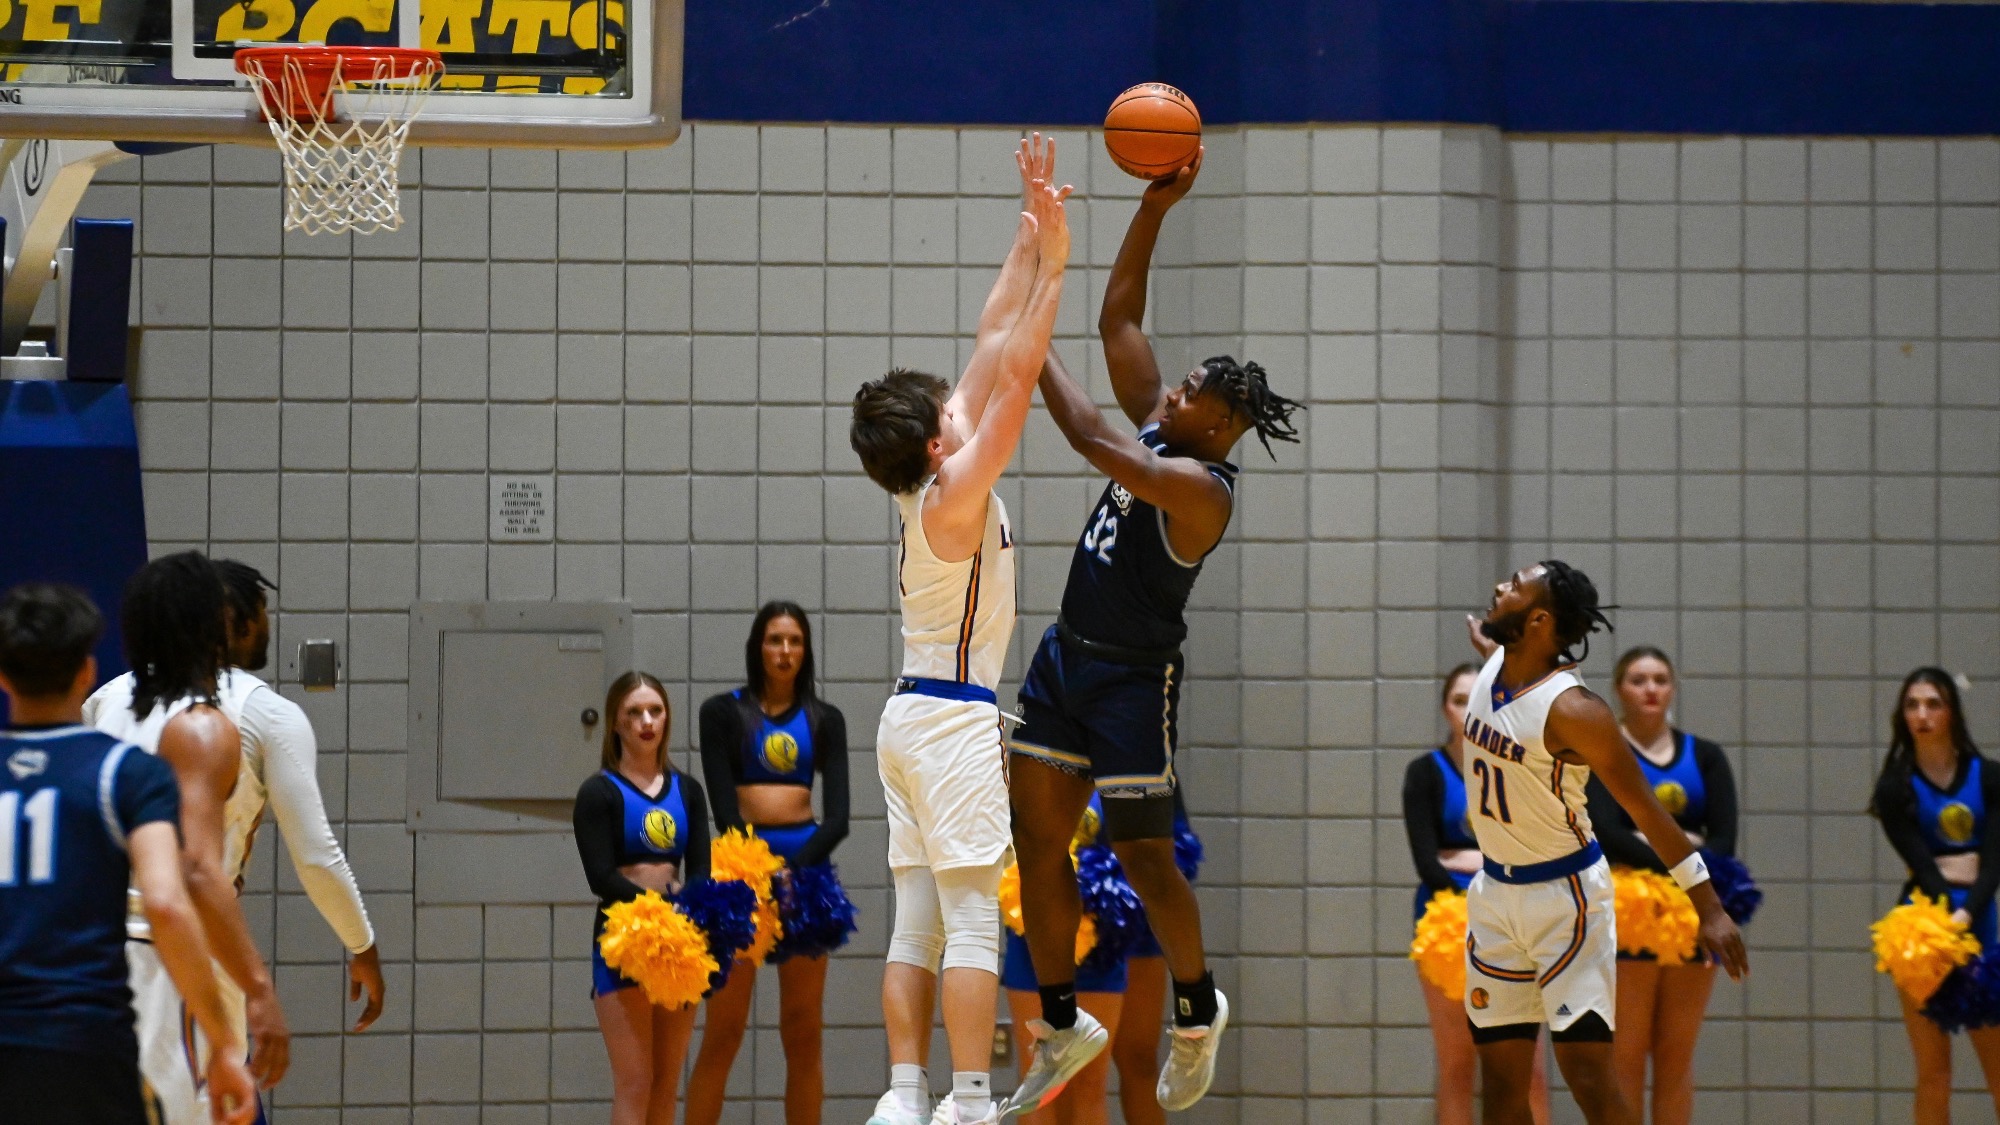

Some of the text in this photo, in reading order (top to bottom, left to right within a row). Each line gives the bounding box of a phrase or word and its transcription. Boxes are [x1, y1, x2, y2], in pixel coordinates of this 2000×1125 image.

[1084, 503, 1118, 567] 32
[1463, 711, 1526, 766] LANDER
[1472, 756, 1513, 825] 21
[0, 787, 60, 887] 11
